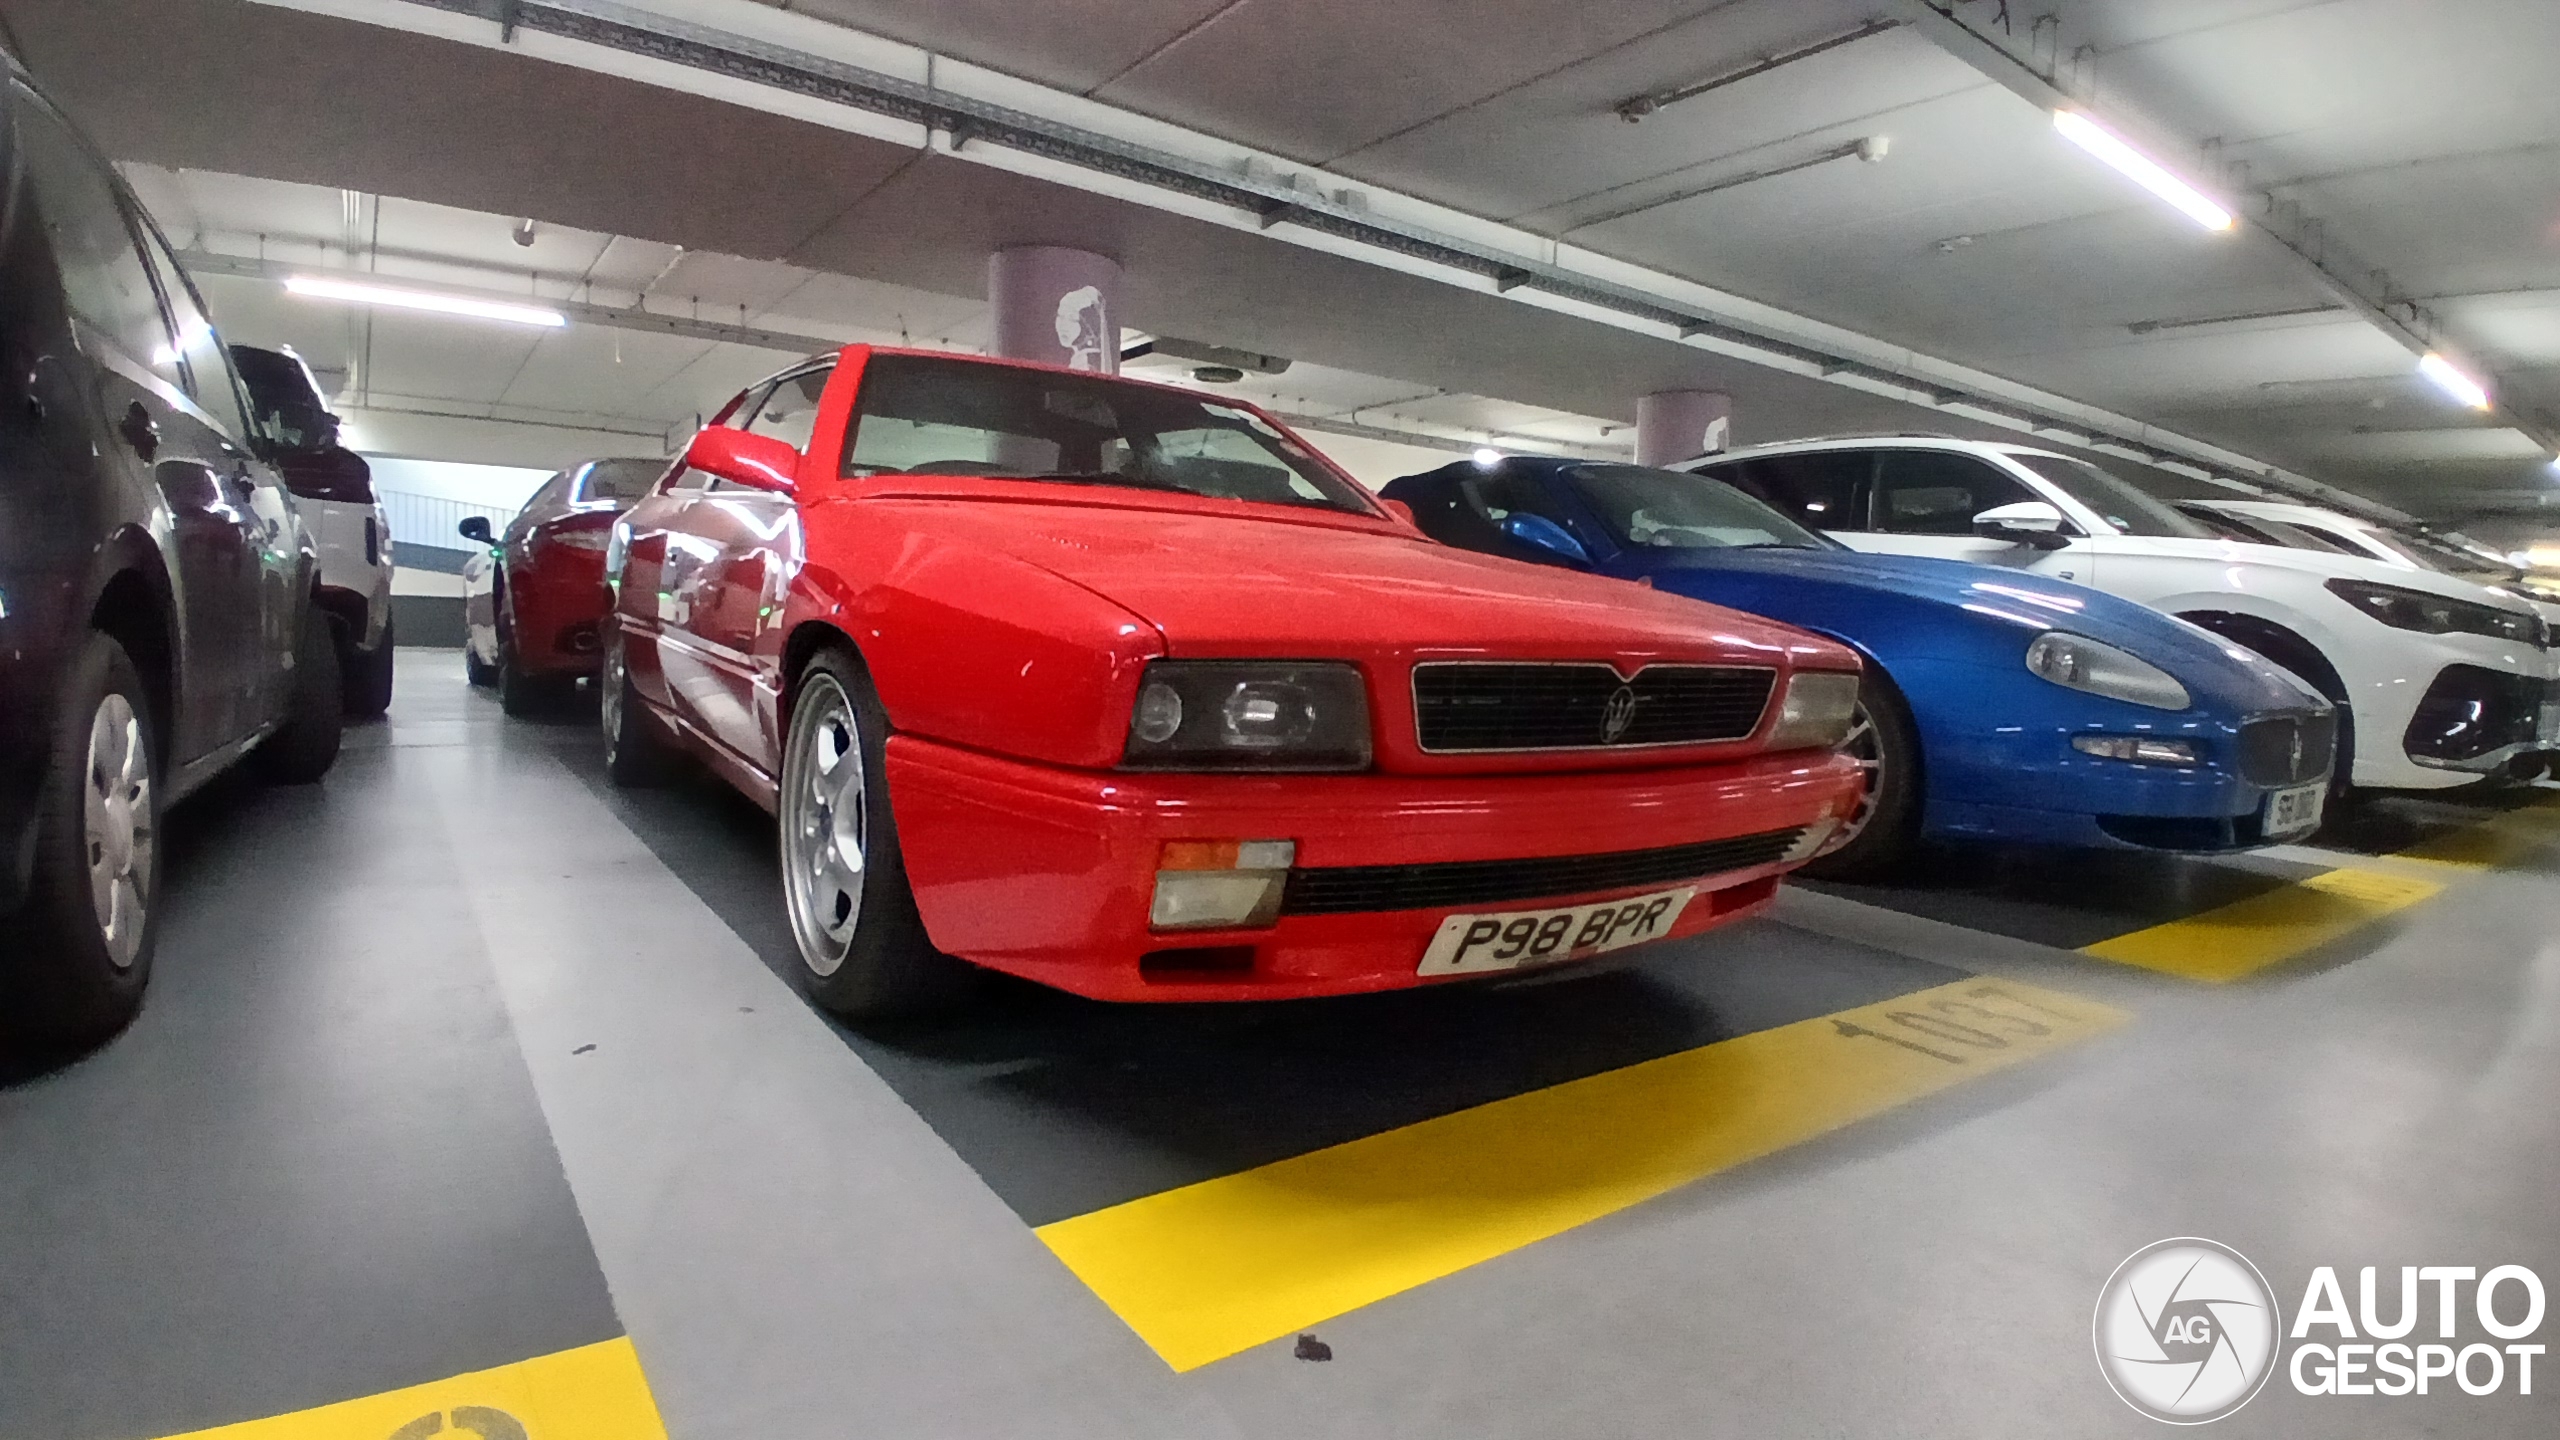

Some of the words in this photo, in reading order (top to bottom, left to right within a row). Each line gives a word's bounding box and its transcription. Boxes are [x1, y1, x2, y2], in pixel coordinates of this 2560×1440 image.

[1451, 913, 1573, 965] P98
[1570, 896, 1674, 949] BPR
[1830, 986, 2083, 1065] 1037
